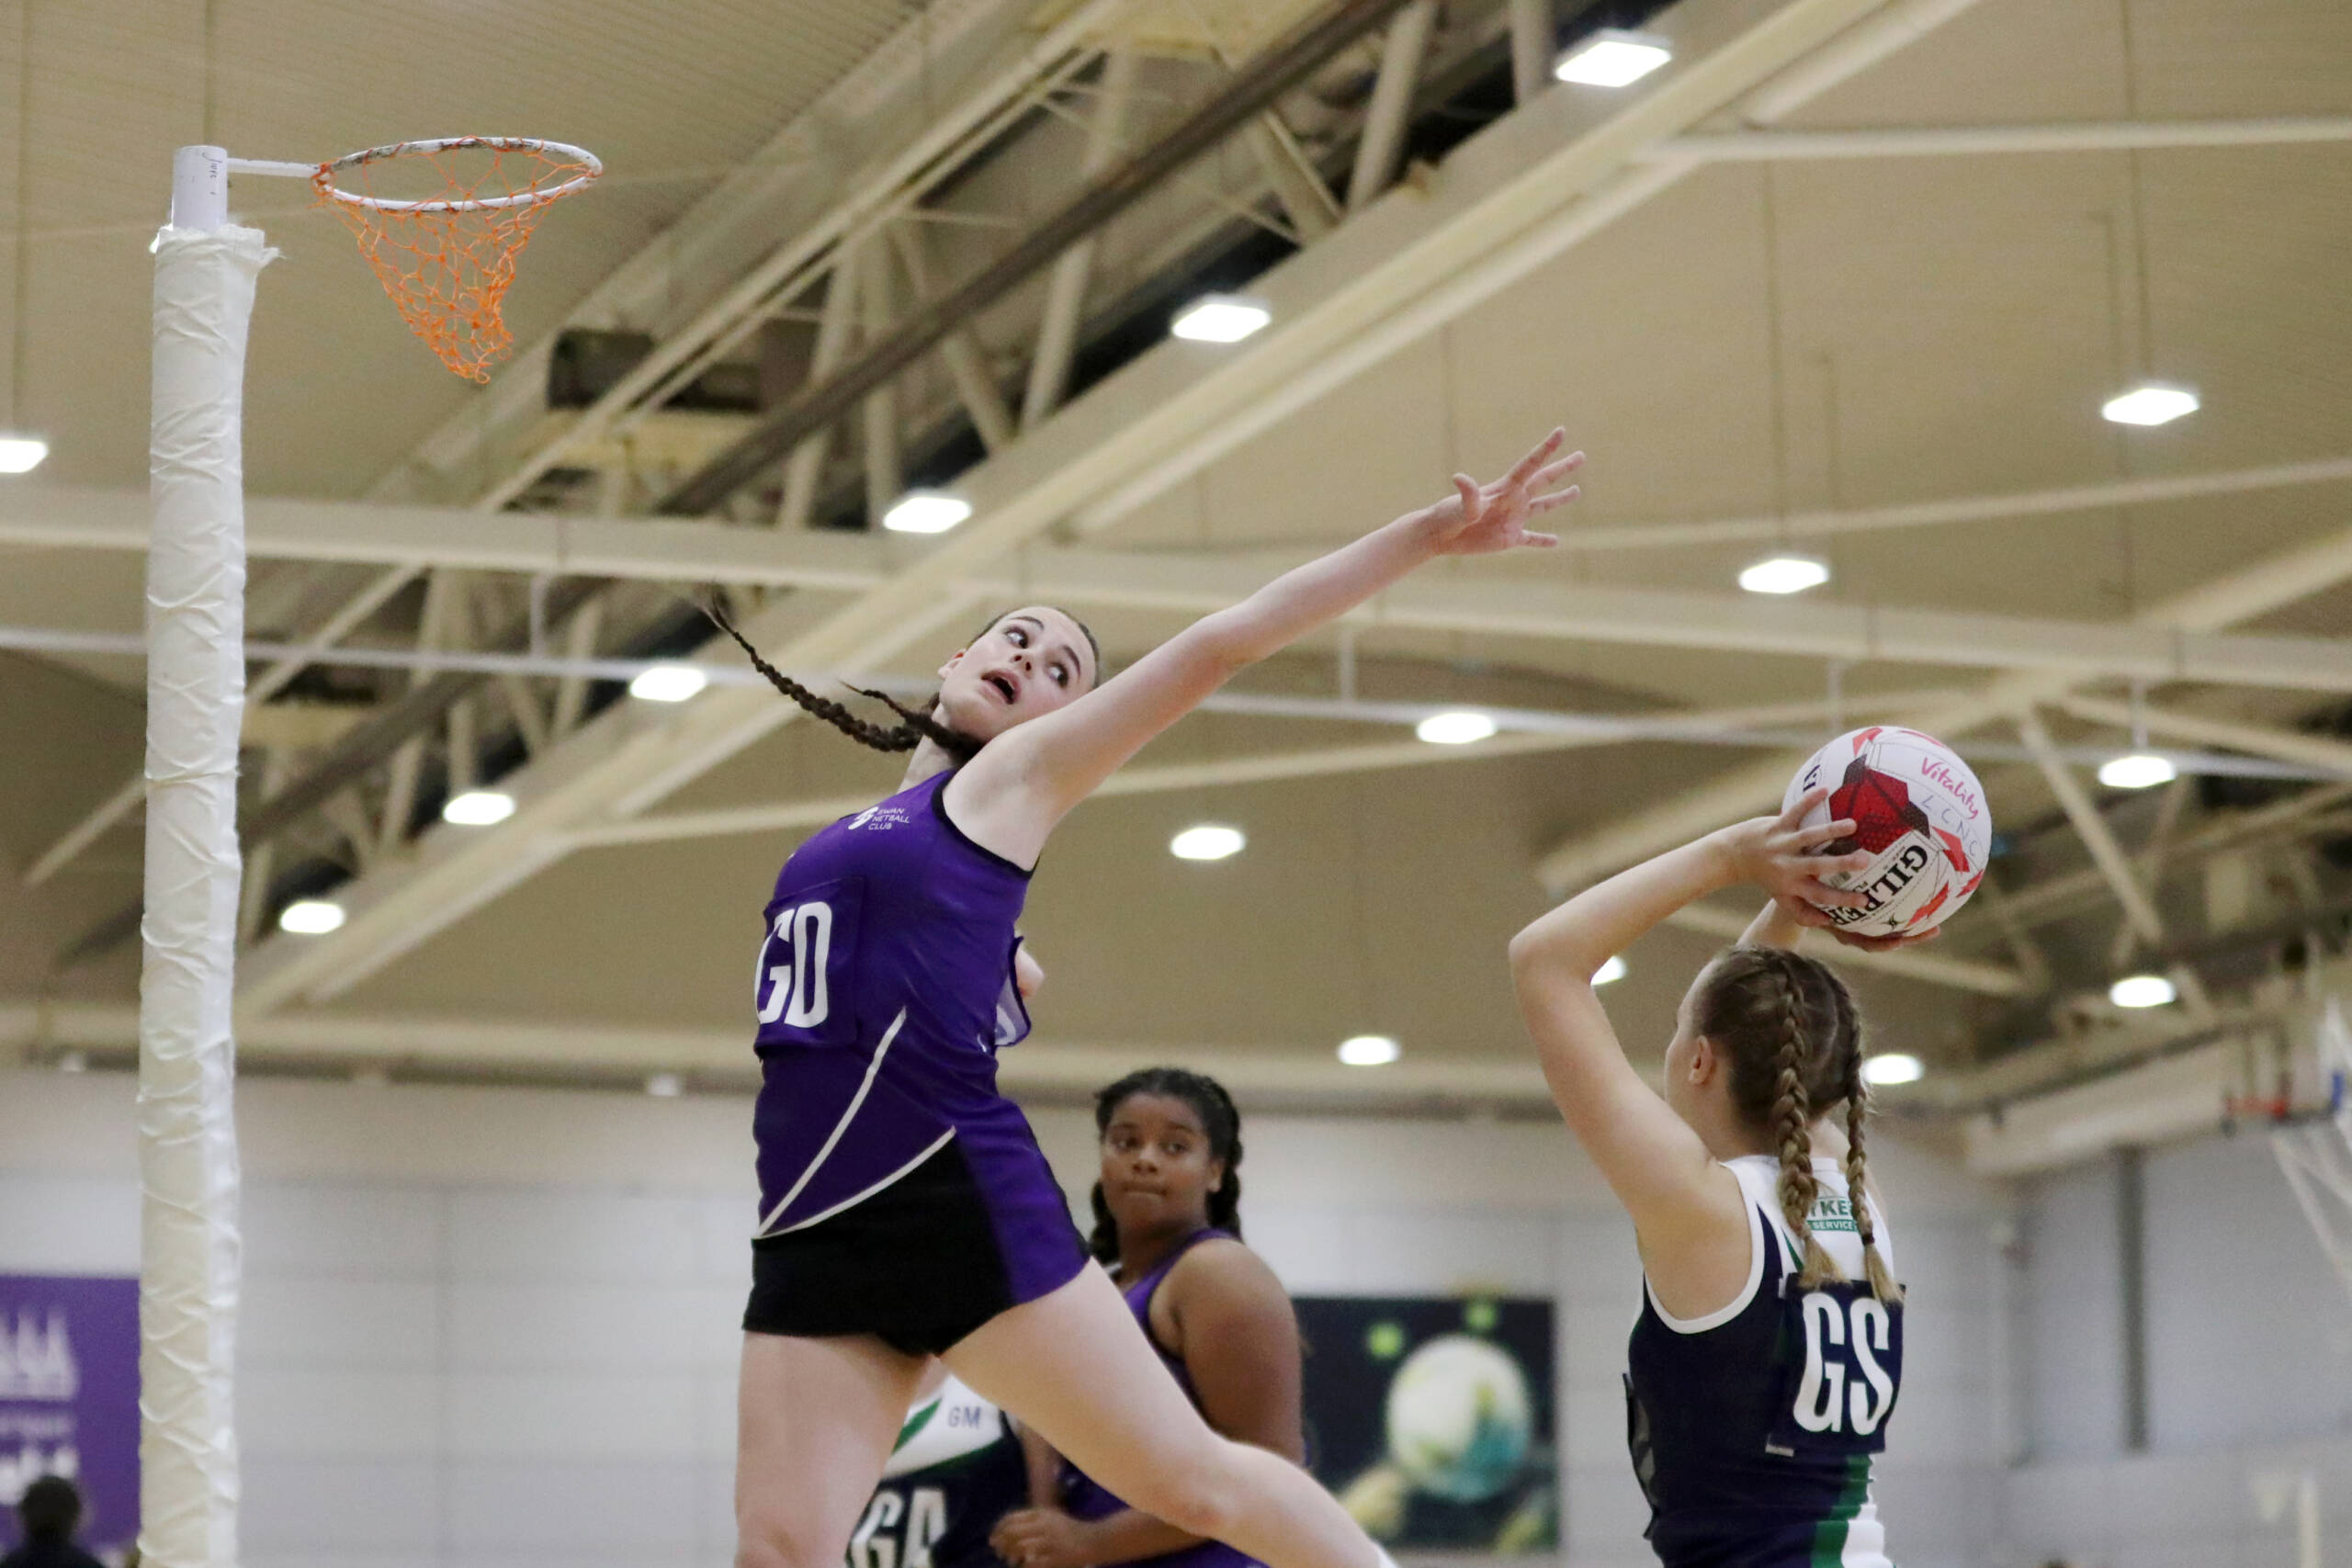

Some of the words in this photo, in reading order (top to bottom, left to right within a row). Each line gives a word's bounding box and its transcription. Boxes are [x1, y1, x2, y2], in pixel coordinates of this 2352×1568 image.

[872, 815, 910, 824] NETBALL
[1921, 756, 1979, 820] Vitality
[868, 822, 892, 830] CLUB
[1826, 845, 1928, 926] GILBER
[754, 901, 832, 1029] GD
[1808, 1199, 1852, 1217] YKE
[1793, 1292, 1894, 1436] GS
[948, 1405, 982, 1429] GM
[849, 1488, 947, 1568] GA
